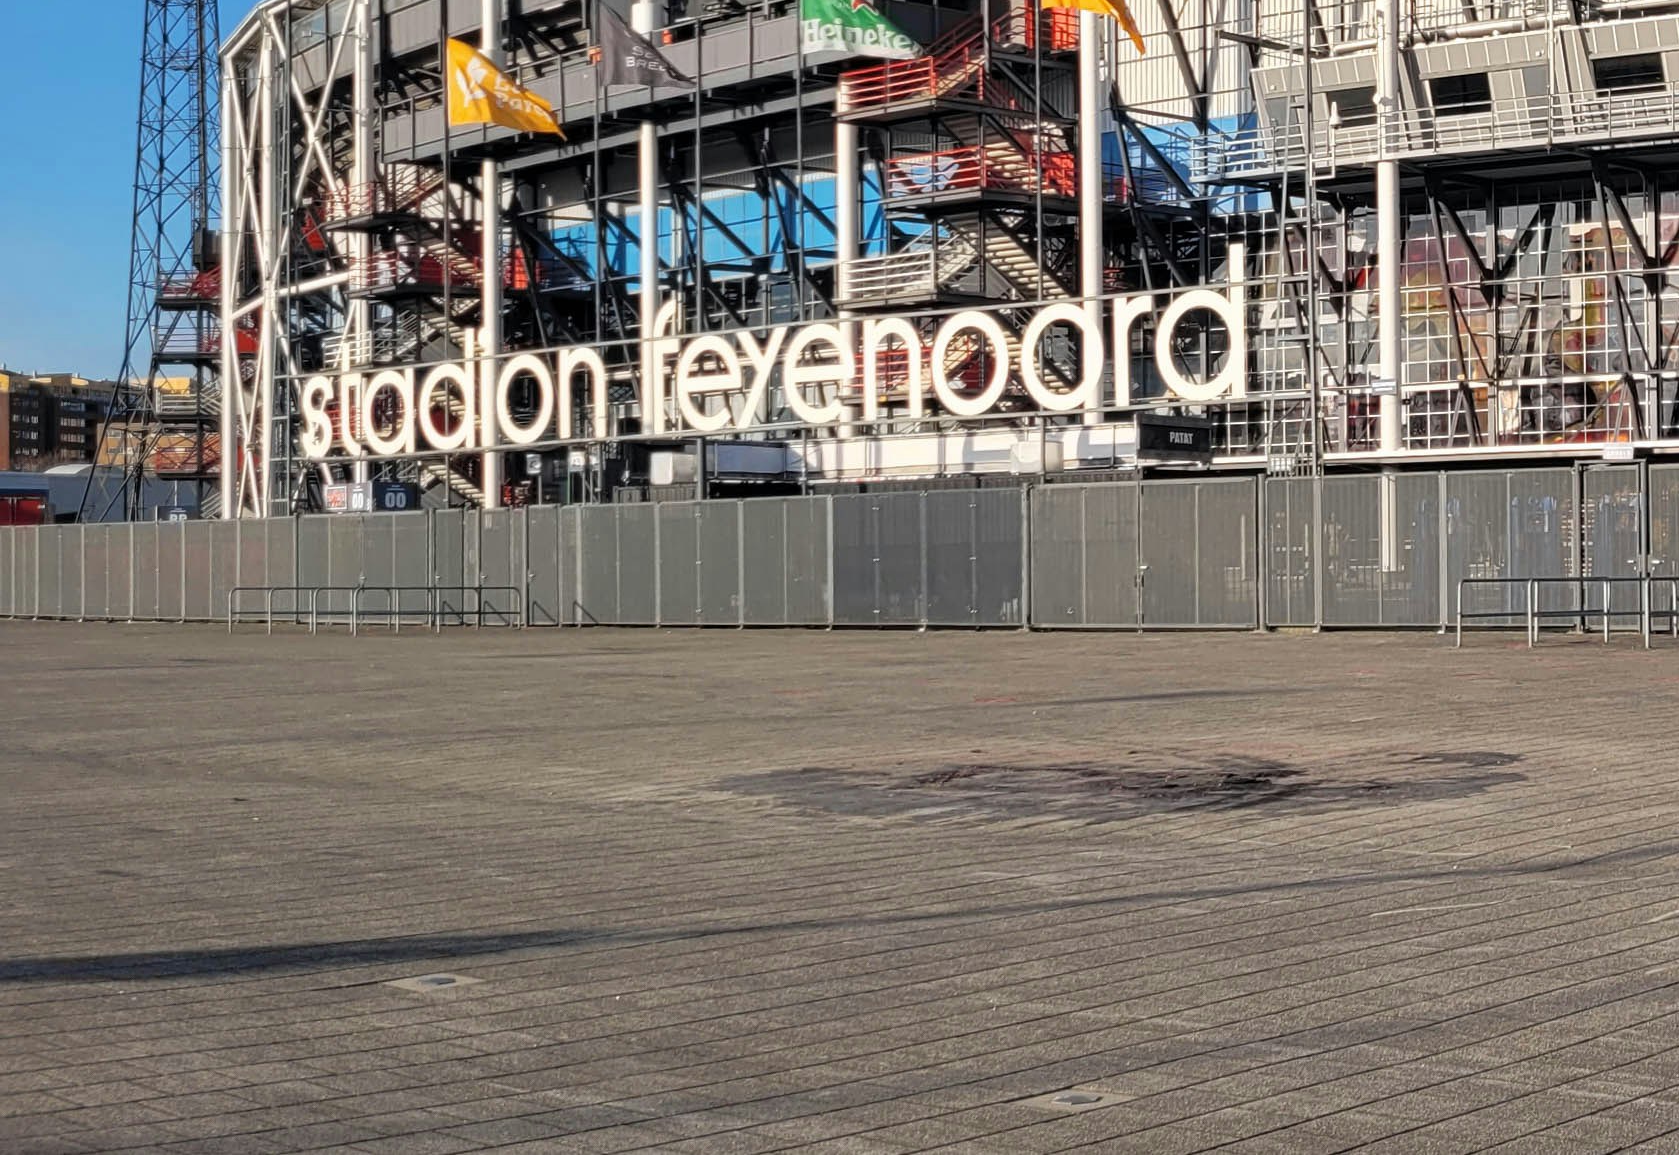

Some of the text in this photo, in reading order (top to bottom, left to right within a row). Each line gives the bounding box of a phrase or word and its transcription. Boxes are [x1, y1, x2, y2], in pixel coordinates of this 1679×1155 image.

[302, 243, 1245, 460] stadion feyenoord
[1169, 431, 1194, 445] PATAT
